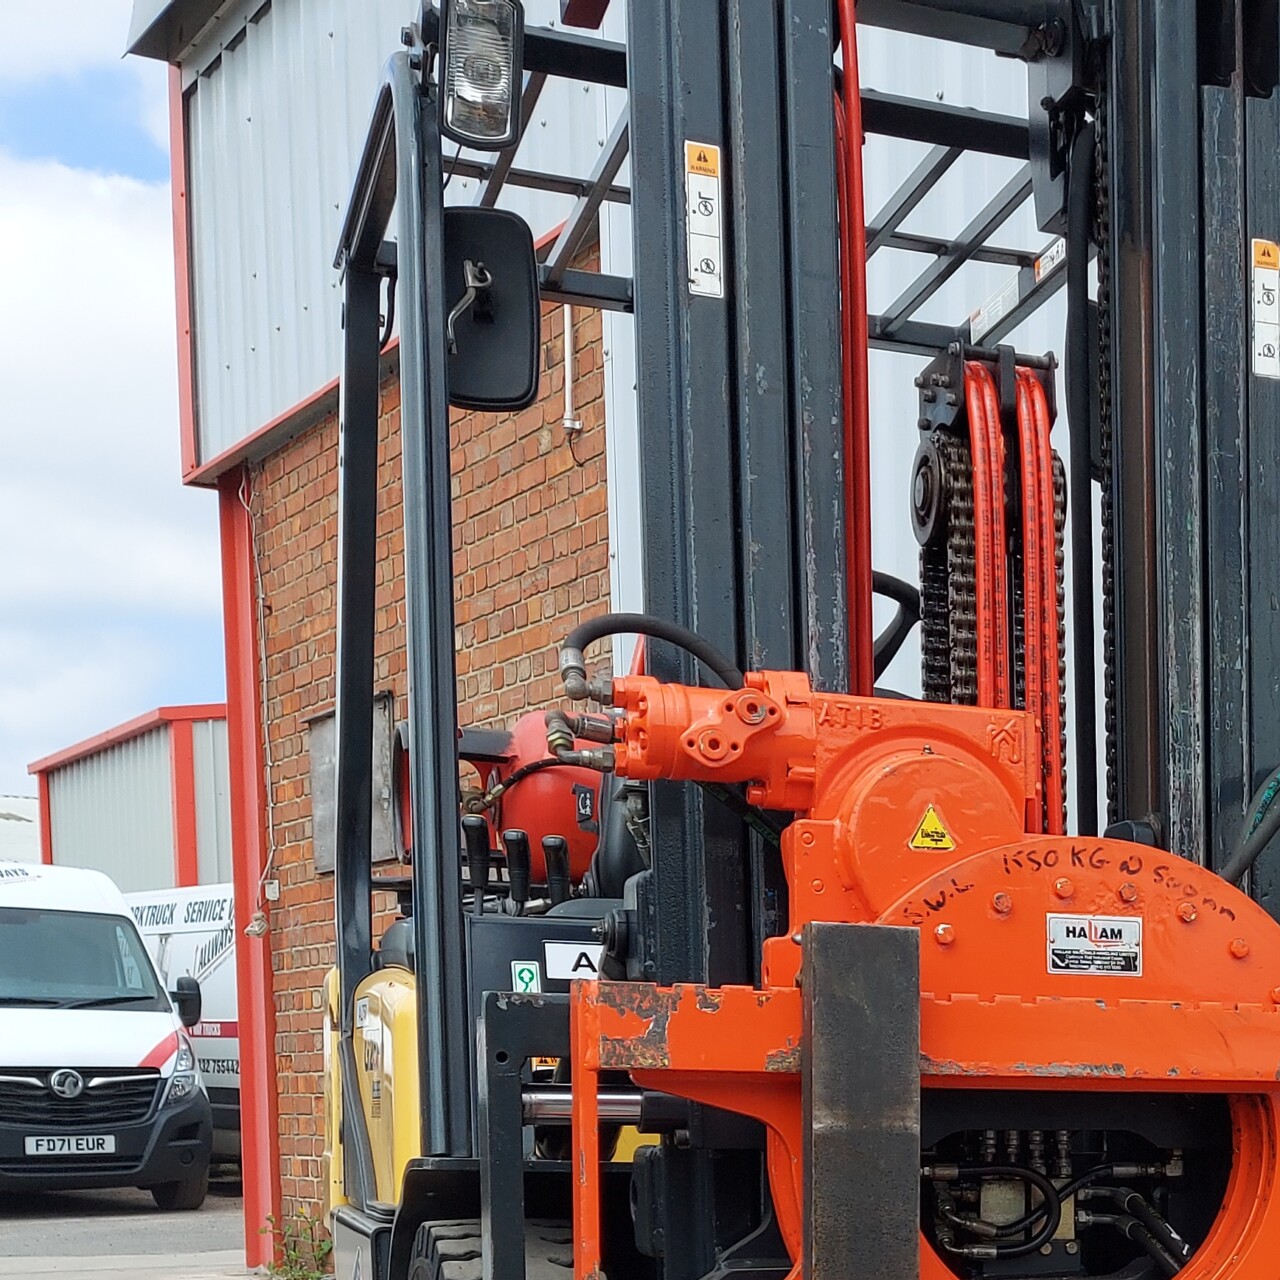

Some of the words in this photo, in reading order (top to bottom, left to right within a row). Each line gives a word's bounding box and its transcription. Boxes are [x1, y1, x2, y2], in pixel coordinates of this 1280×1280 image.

[183, 898, 228, 924] SERVICE
[198, 918, 234, 975] ALLWAYS
[35, 1138, 71, 1152] FD71
[75, 1137, 106, 1151] EUR
